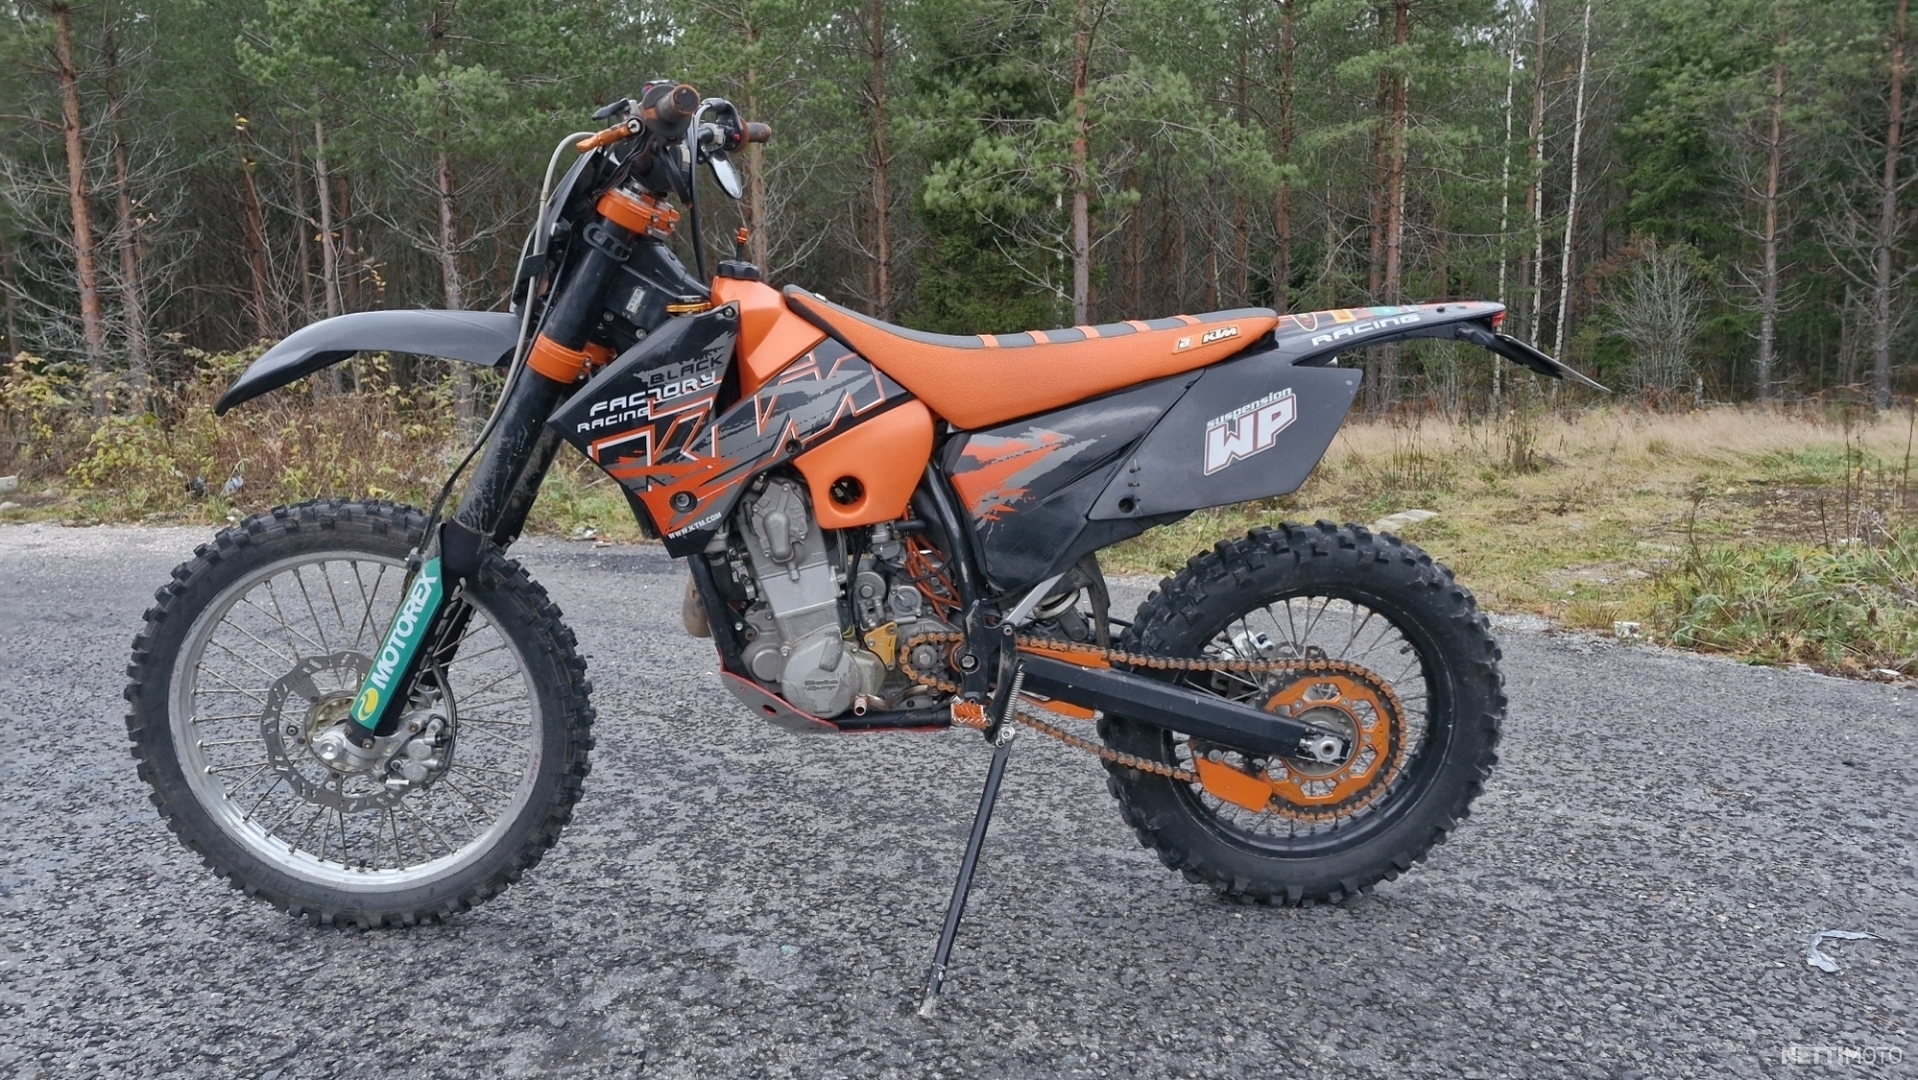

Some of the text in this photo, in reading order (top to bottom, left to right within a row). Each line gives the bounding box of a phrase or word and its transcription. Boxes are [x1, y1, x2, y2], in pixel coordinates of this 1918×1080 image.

[1201, 326, 1239, 344] KTM
[1311, 314, 1421, 346] RACING
[650, 353, 724, 385] BLACK
[589, 370, 716, 417] FACTORY
[1206, 387, 1292, 429] suspension
[577, 406, 649, 433] RACING
[1204, 393, 1297, 476] WP
[667, 511, 722, 540] WWW.KTM.COM
[370, 575, 438, 690] MOTOREX
